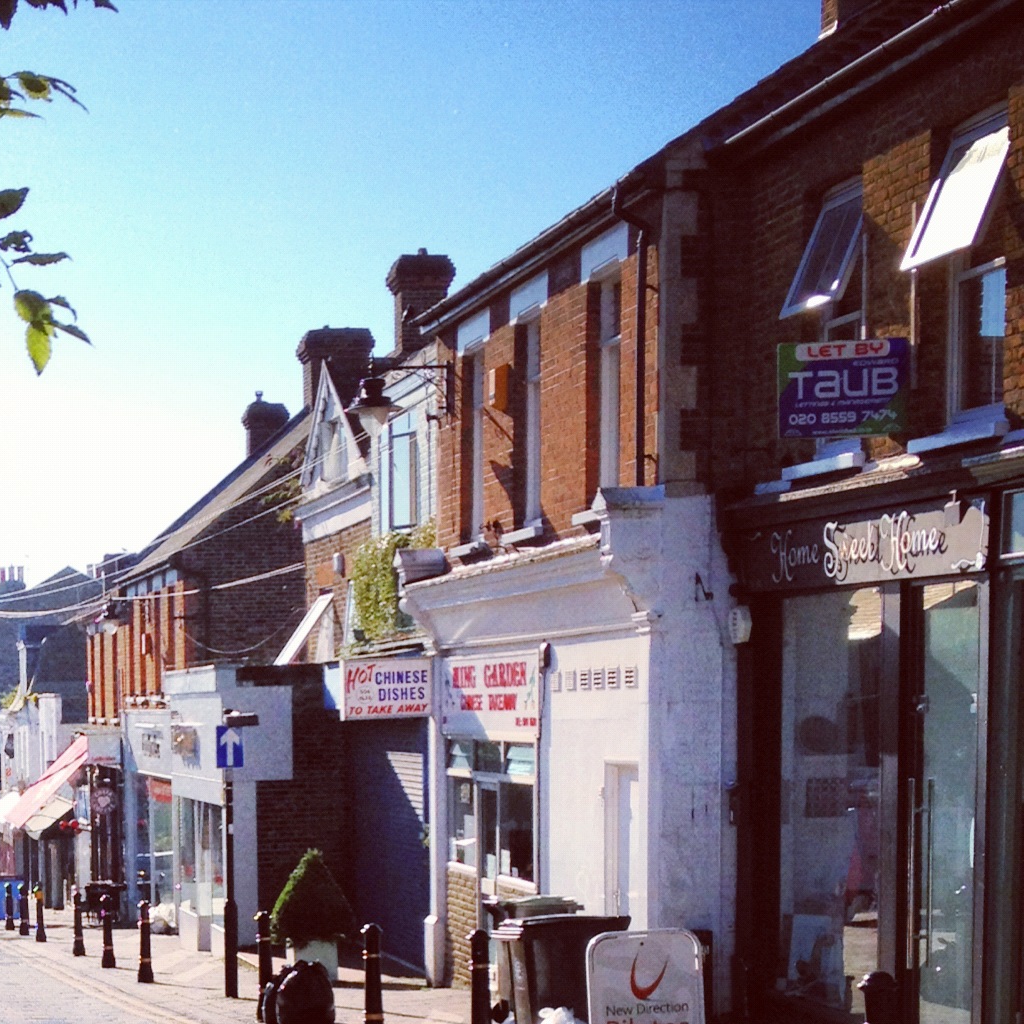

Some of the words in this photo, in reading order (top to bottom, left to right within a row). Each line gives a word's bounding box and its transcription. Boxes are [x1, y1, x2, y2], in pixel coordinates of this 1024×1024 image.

[807, 344, 846, 358] LET
[855, 342, 884, 356] BY
[788, 413, 817, 426] 020
[821, 411, 857, 424] 8559
[861, 409, 898, 422] 7474
[770, 530, 819, 582] Home
[823, 521, 878, 578] Sweet
[880, 510, 940, 572] Home
[346, 663, 376, 694] HOT
[375, 670, 428, 685] CHINESE
[378, 687, 425, 701] DISHES
[349, 706, 363, 715] TO
[367, 705, 393, 715] TAKE
[397, 703, 428, 713] AWAY
[606, 1005, 633, 1017] New
[636, 1002, 689, 1015] Direction
